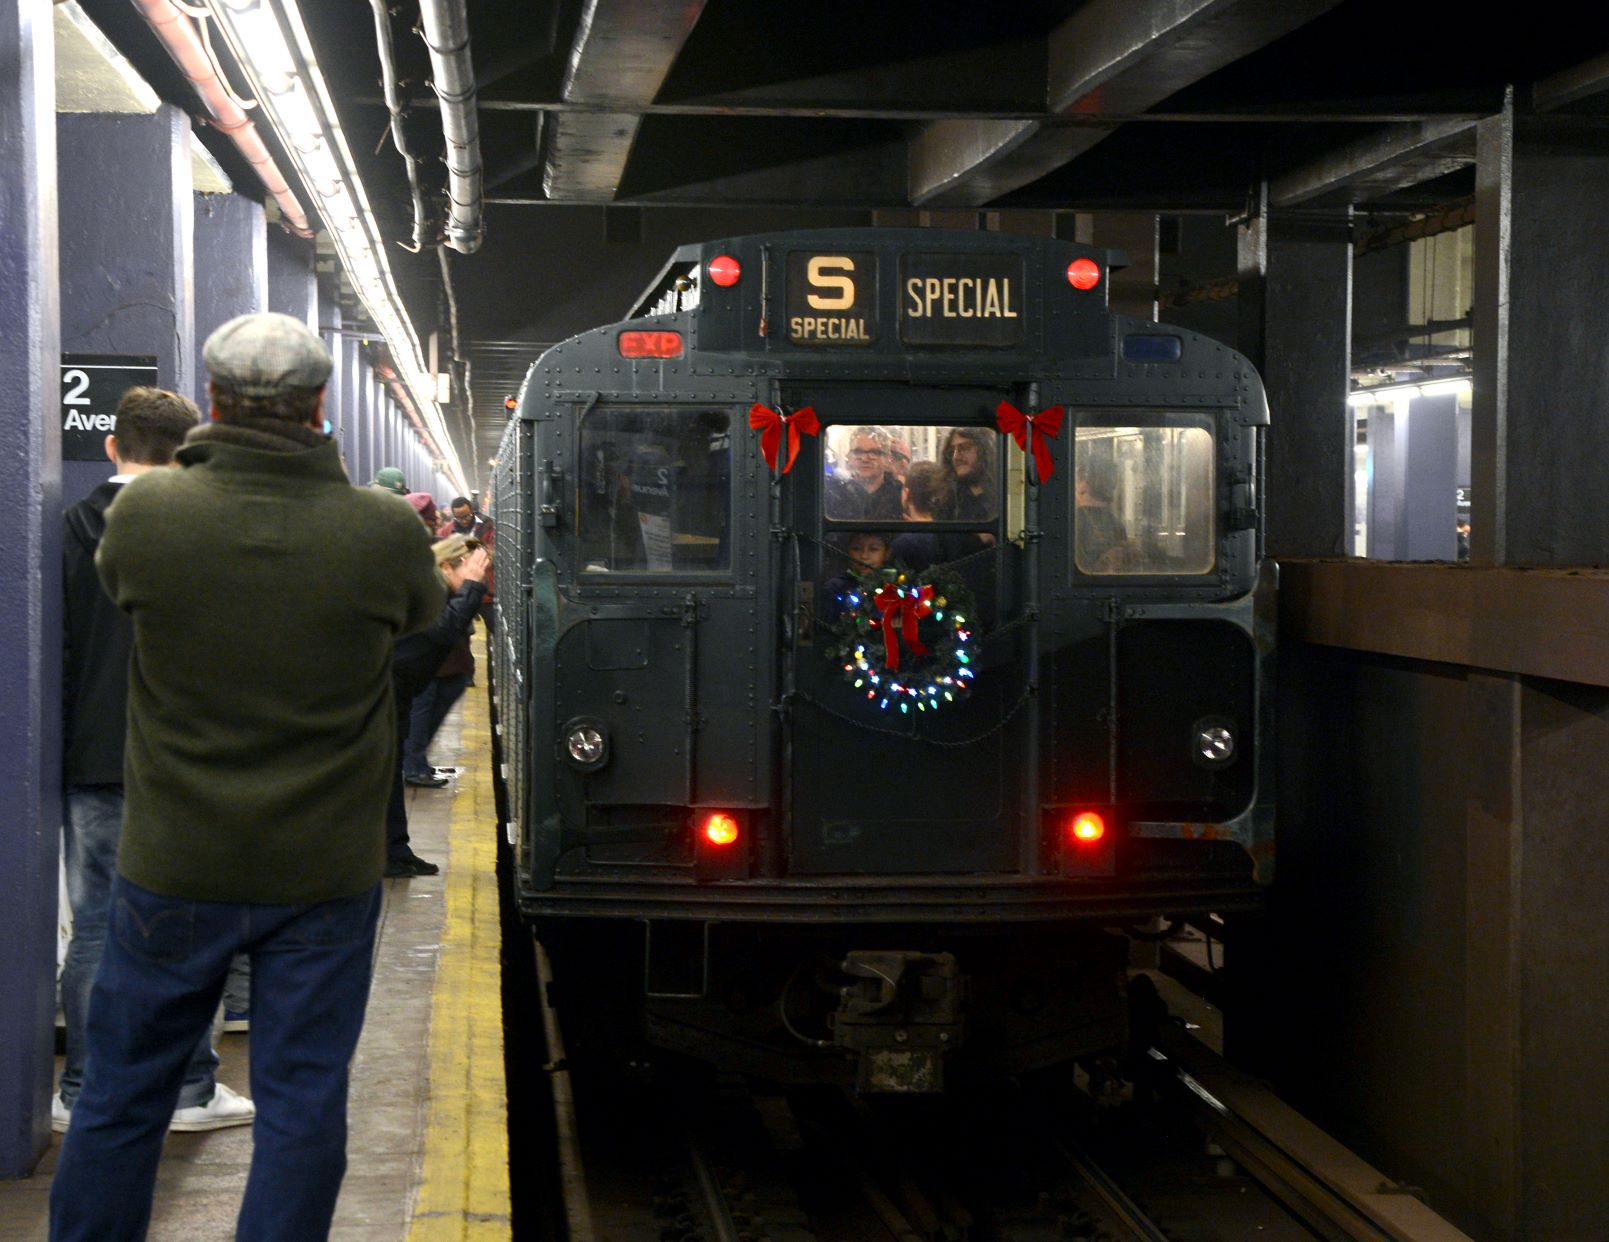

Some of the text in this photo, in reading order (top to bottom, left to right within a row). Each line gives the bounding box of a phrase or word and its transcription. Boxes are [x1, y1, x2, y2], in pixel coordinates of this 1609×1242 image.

[807, 256, 855, 310] S
[907, 278, 1018, 318] SPECIAL
[791, 317, 870, 340] SPECIAL
[623, 332, 681, 357] EXP
[63, 369, 91, 405] 2
[63, 409, 117, 431] Ave
[1456, 489, 1465, 500] 2
